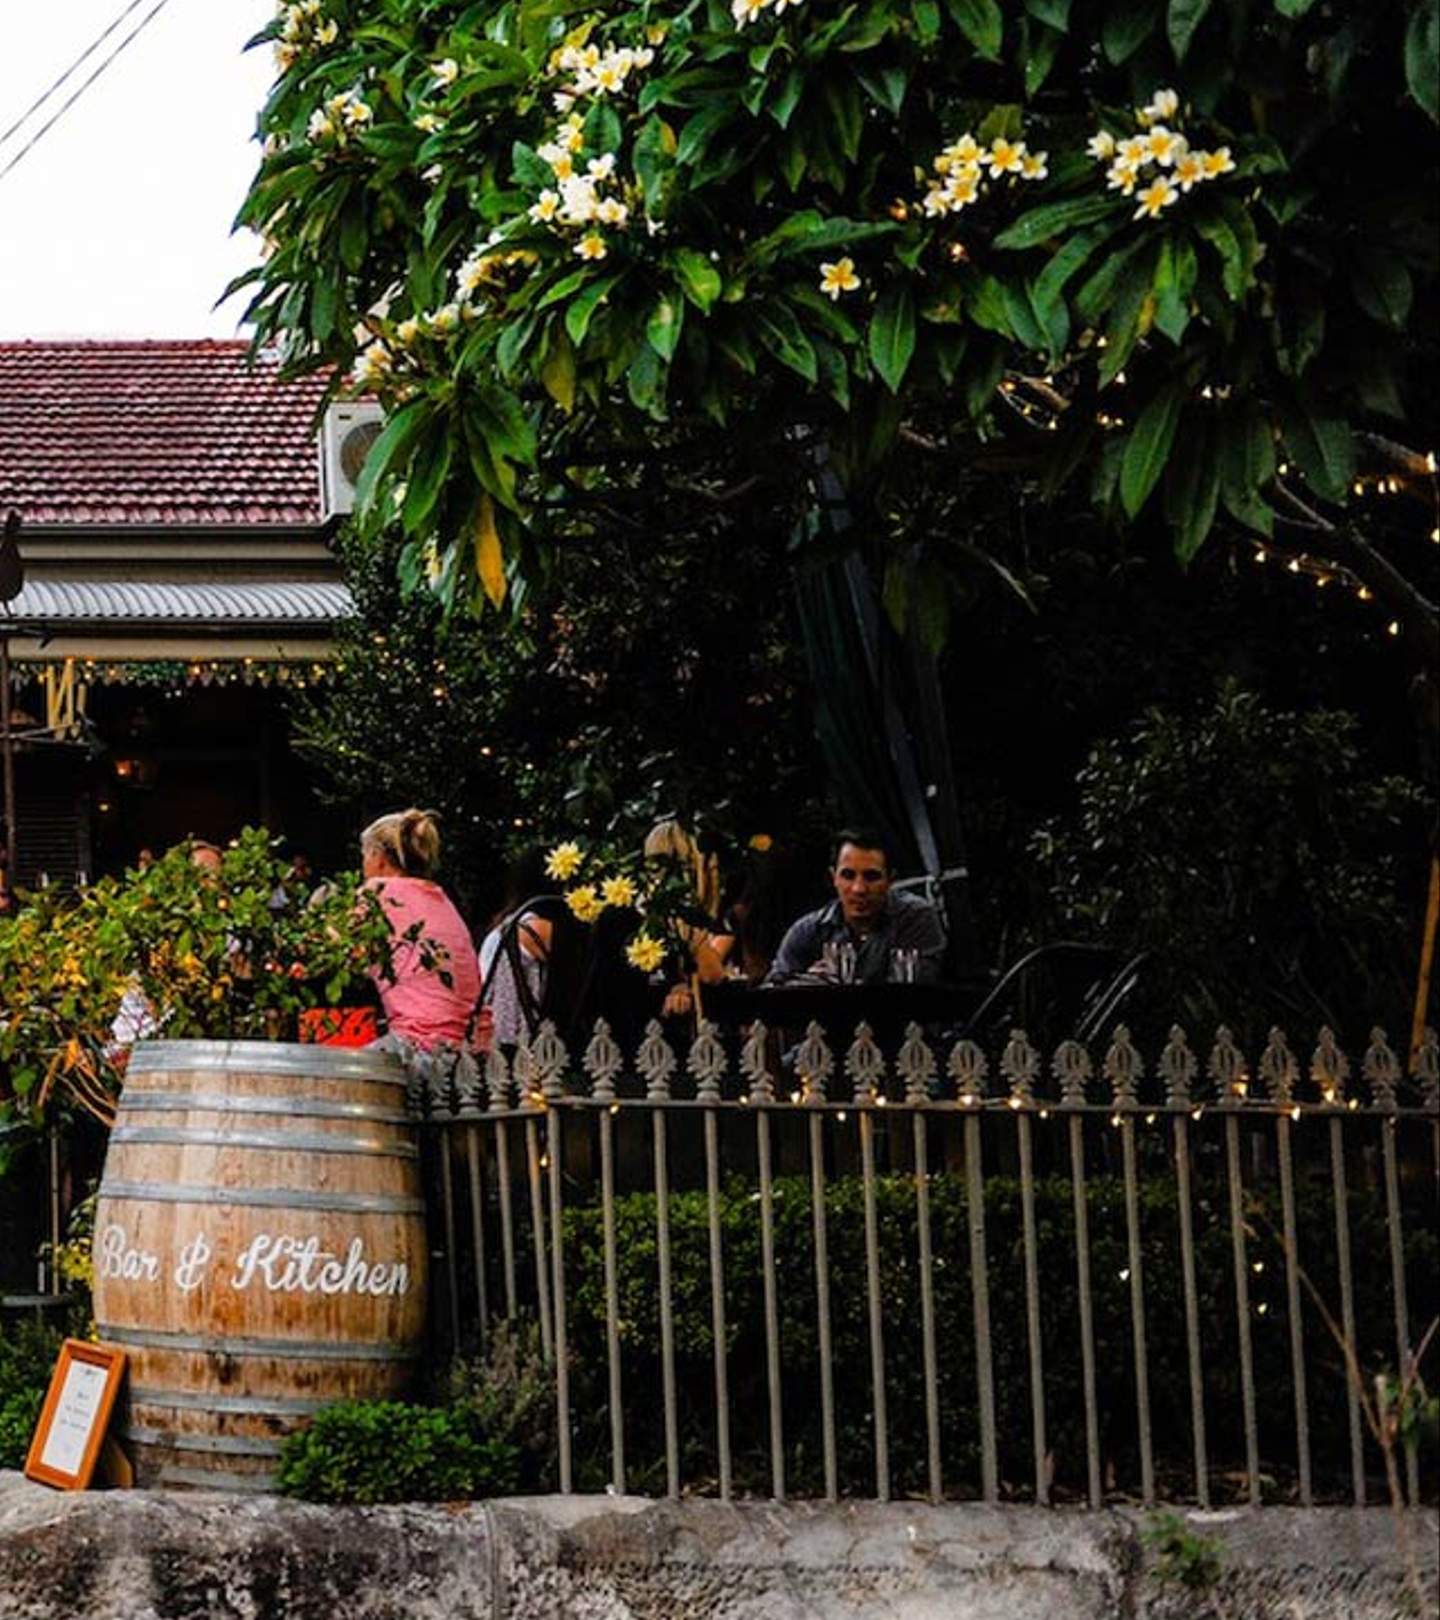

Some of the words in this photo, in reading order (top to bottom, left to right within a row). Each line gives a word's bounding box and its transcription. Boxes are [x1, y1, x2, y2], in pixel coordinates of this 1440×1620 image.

[100, 1225, 159, 1281] Bar
[174, 1232, 210, 1293] &
[231, 1233, 408, 1297] Kitchen
